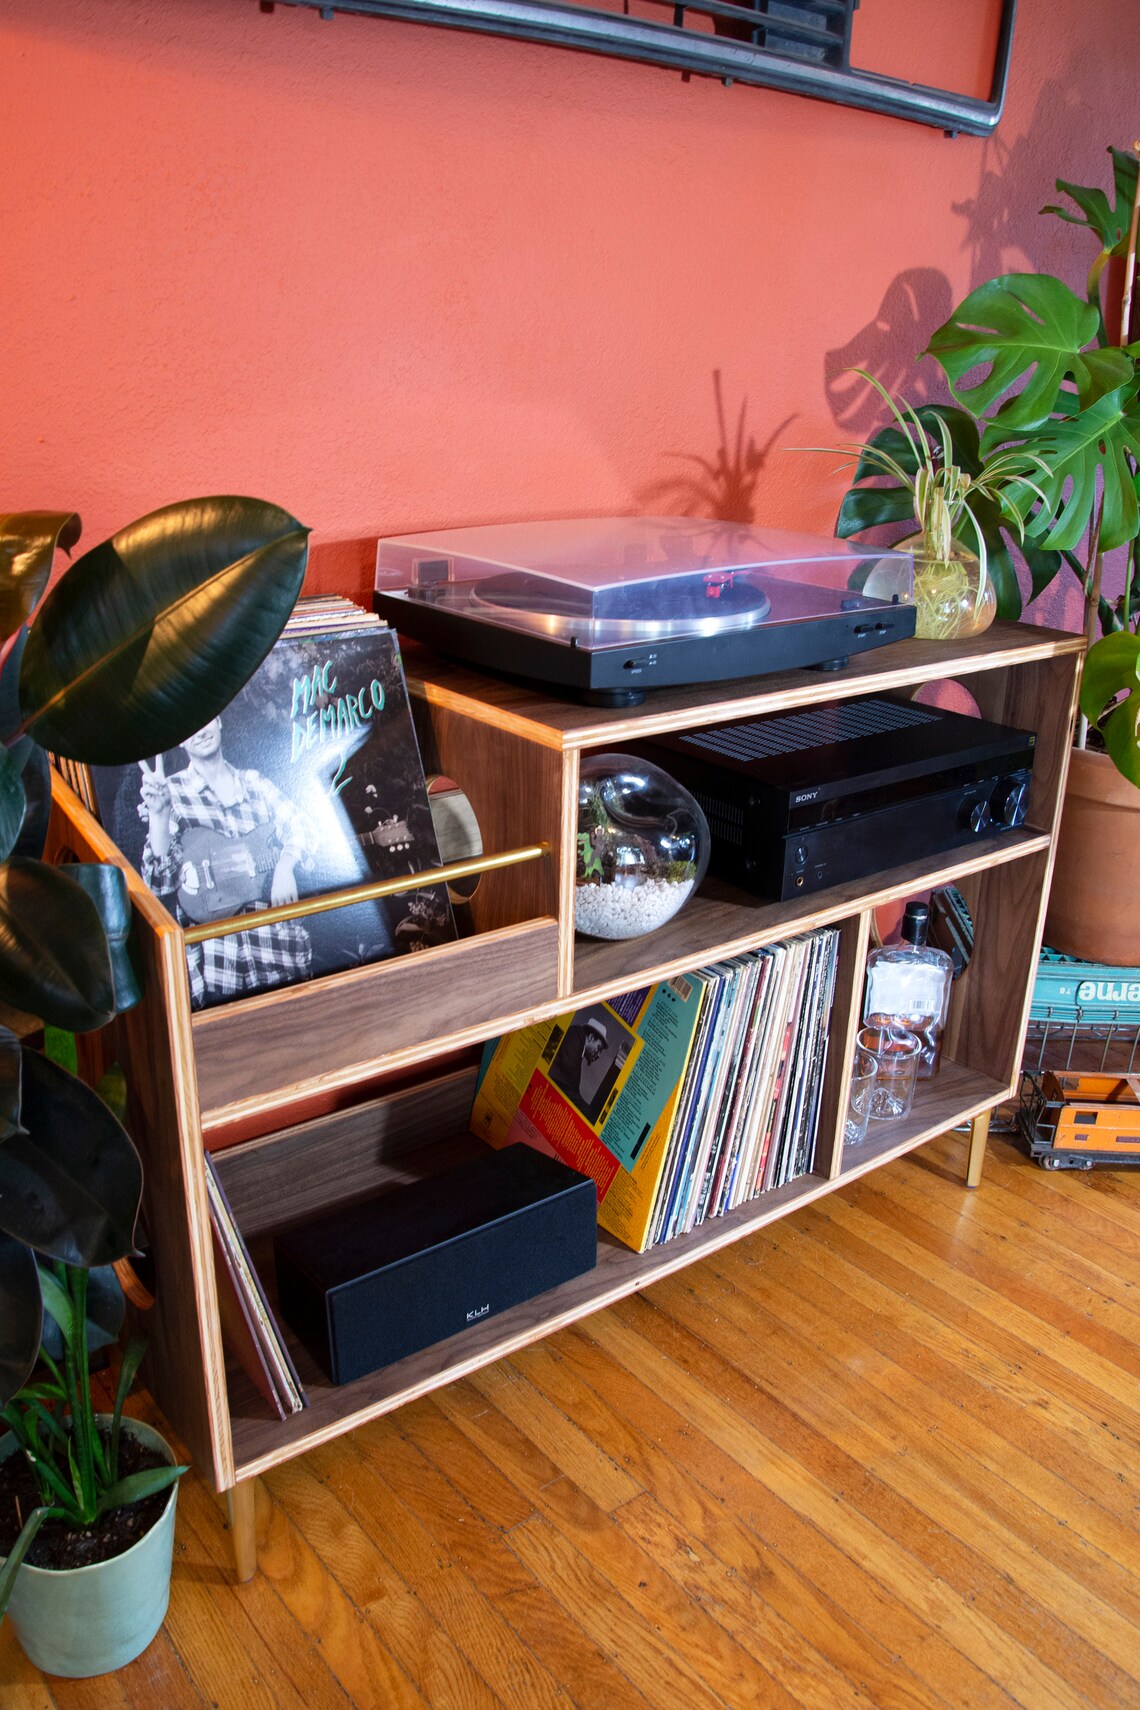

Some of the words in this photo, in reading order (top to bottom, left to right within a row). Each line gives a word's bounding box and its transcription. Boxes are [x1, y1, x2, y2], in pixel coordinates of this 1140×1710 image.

[290, 660, 337, 719] MAC
[290, 679, 385, 763] DEMARCO
[795, 791, 818, 803] SONY
[466, 1303, 490, 1320] KLH
